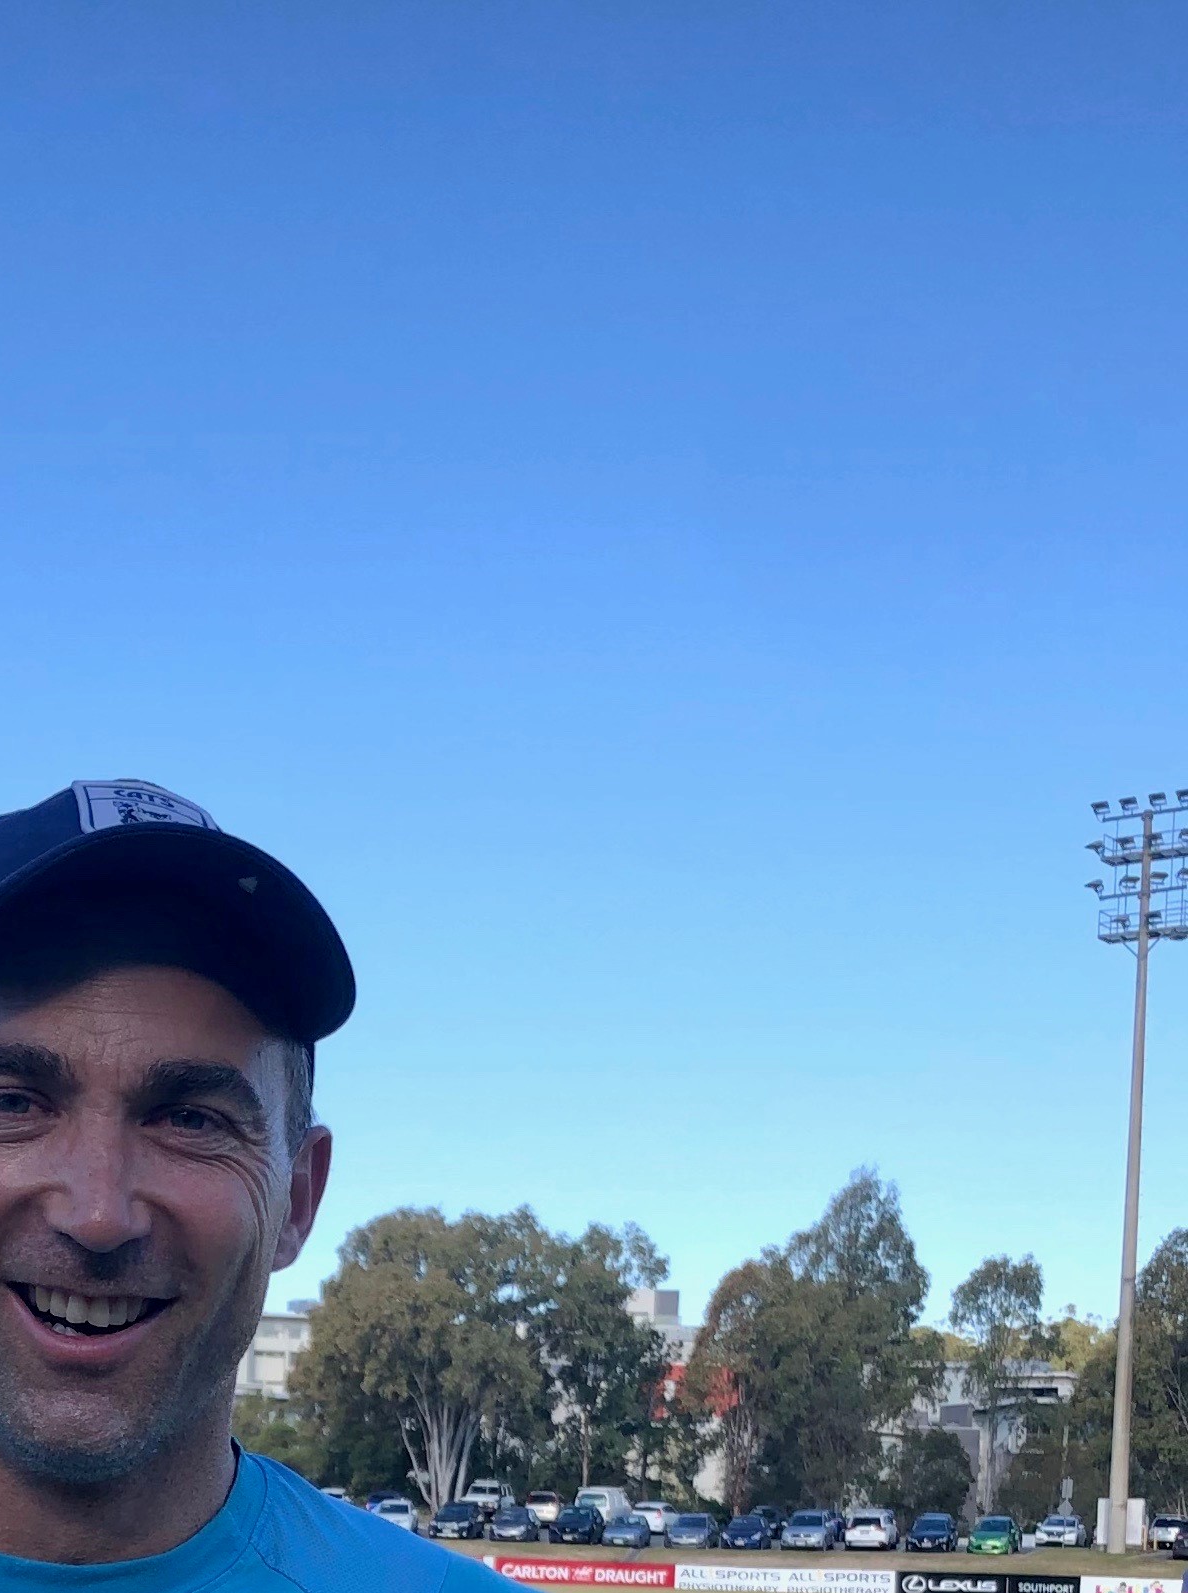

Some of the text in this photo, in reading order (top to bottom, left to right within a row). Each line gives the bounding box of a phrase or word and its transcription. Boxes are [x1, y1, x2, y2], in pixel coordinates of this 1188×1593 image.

[113, 789, 176, 809] CATS
[501, 1563, 569, 1580] CARLTON
[594, 1567, 668, 1585] DRAUGHT
[680, 1568, 781, 1582] ALL SPORTS
[788, 1572, 891, 1584] ALL SPORTS
[678, 1581, 779, 1593] PHYSIOTHERAPY
[928, 1578, 999, 1593] LEXUS
